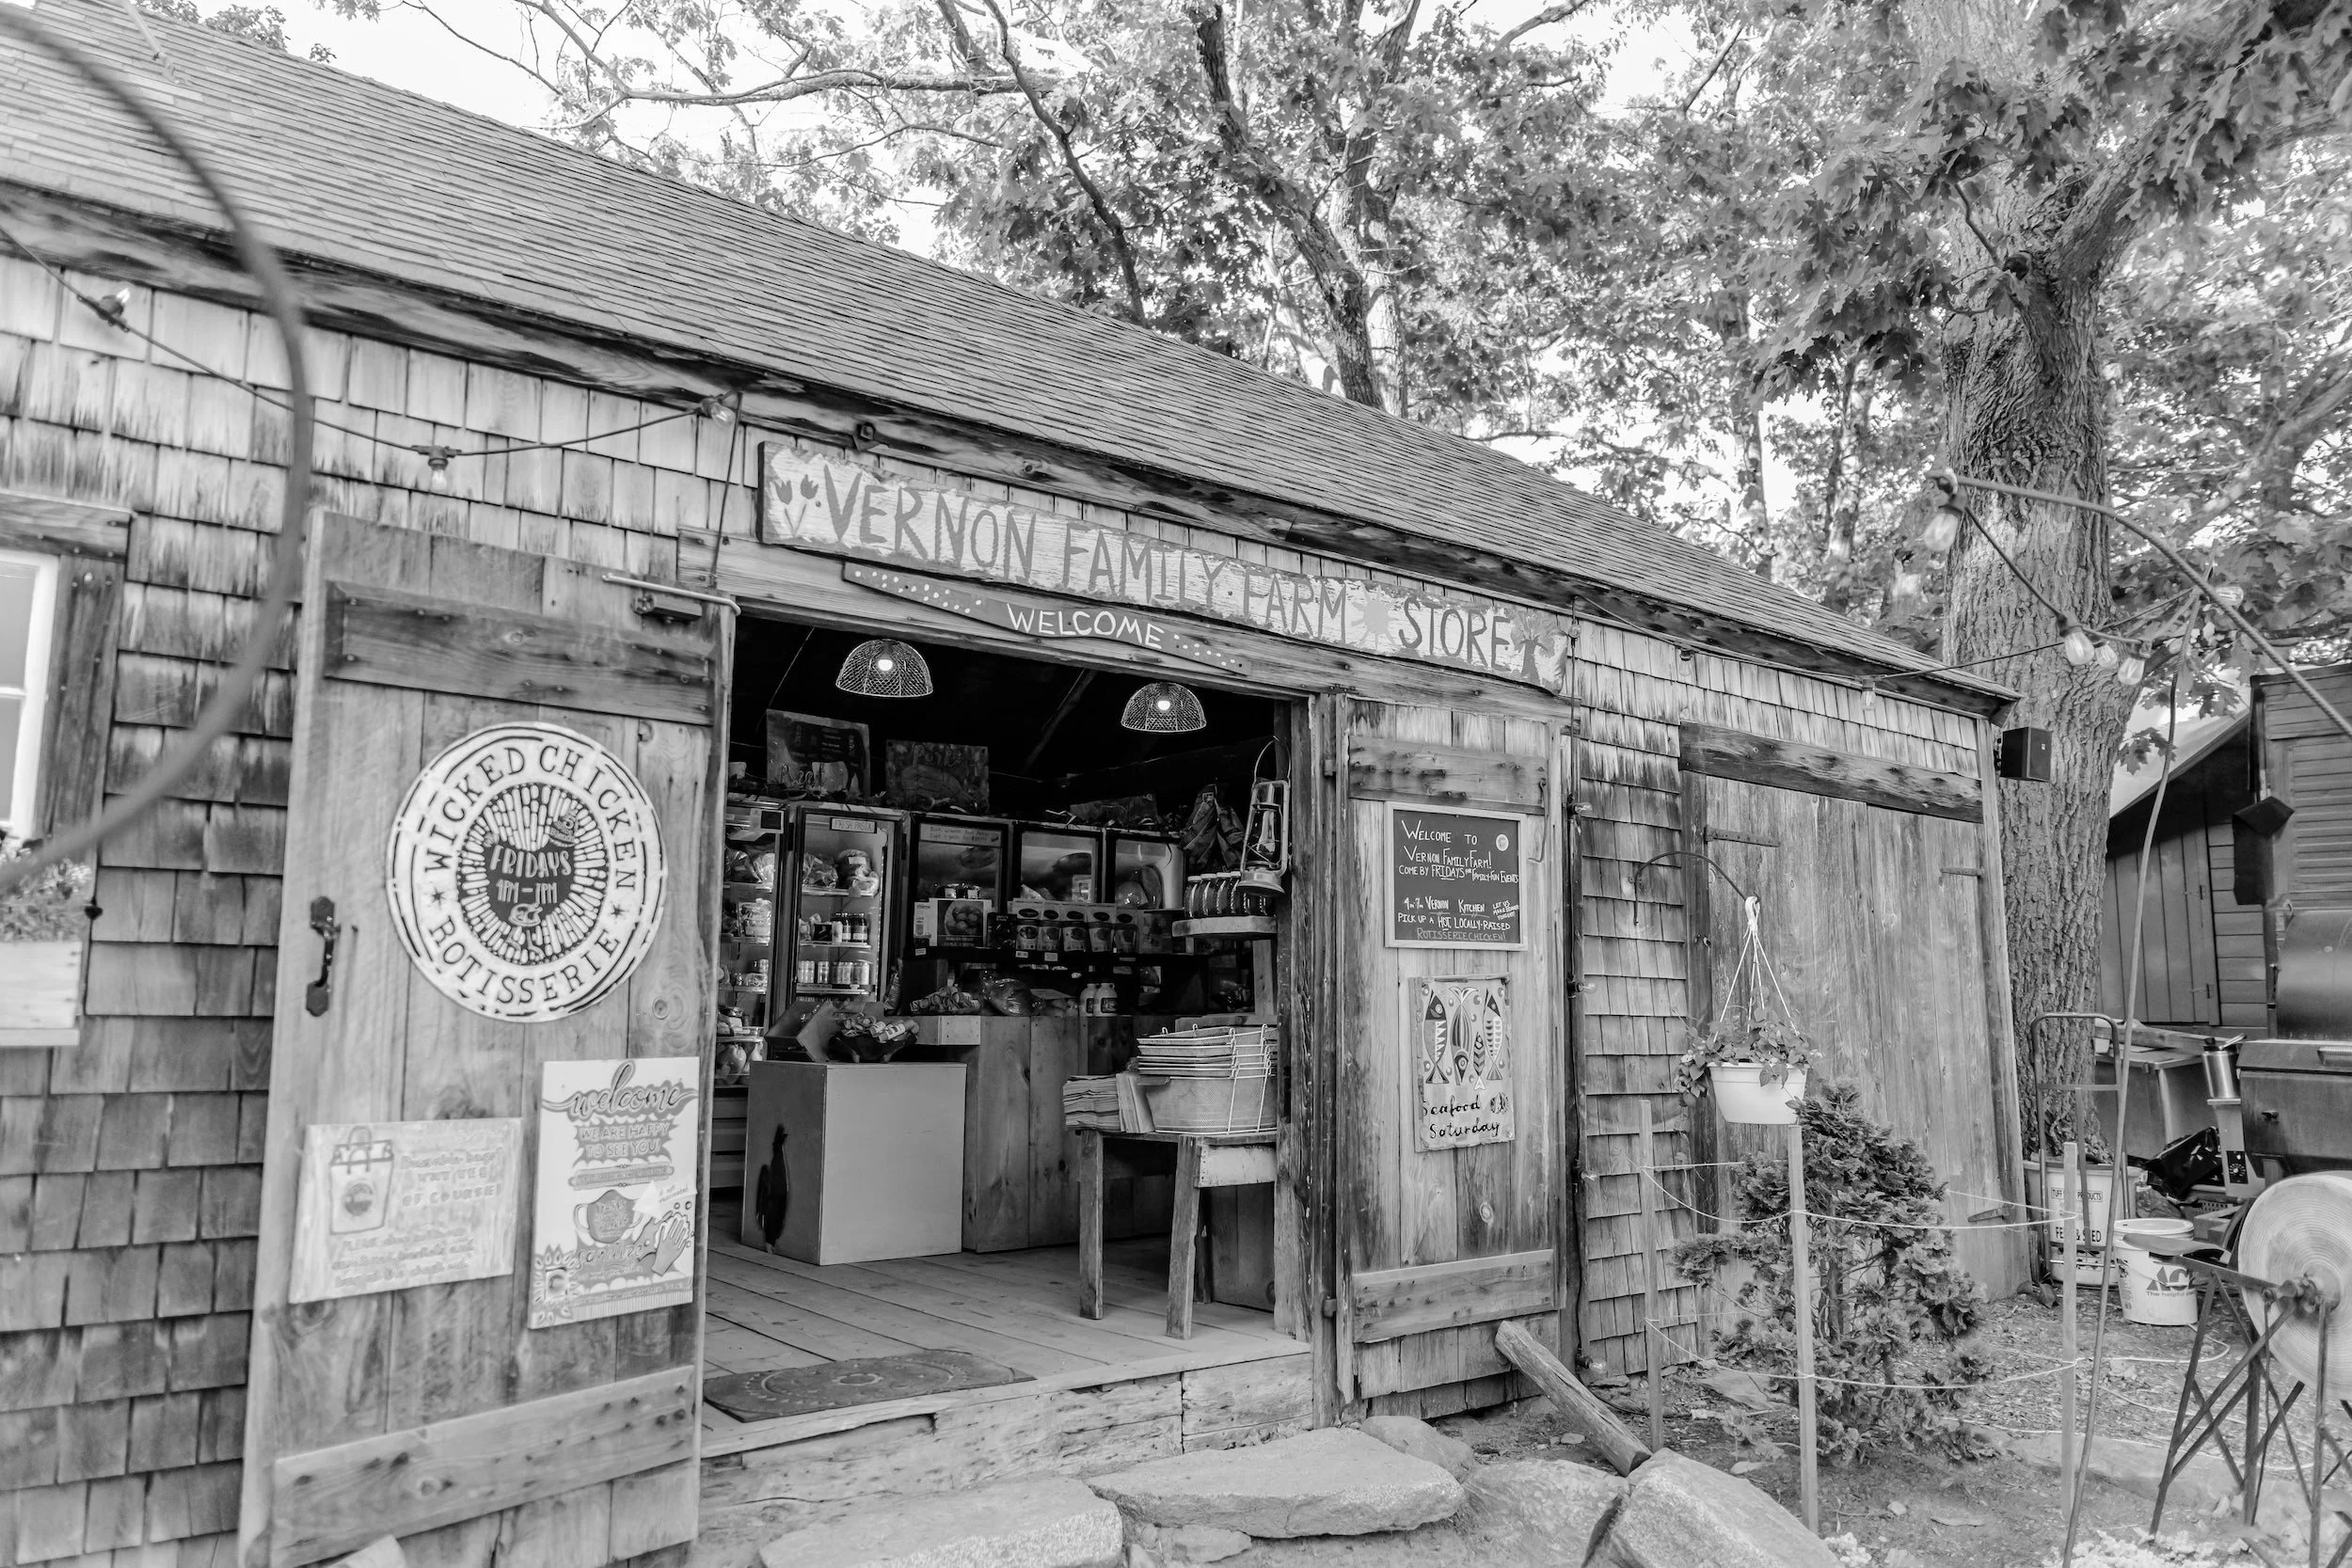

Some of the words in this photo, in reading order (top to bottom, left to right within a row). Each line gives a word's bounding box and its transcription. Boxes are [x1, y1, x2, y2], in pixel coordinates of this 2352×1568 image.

[823, 463, 1037, 583] VERNON
[1061, 521, 1227, 610] FAMILY
[1243, 568, 1347, 645] FARM
[1398, 596, 1511, 672] STORE
[1007, 602, 1166, 650] WELCOME
[424, 747, 526, 872] WICKED
[539, 744, 638, 892] CHICKEN
[1464, 833, 1478, 845] TO
[489, 844, 572, 879] FRIDAYS
[1398, 864, 1419, 876] COME
[1420, 865, 1429, 877] BY
[1431, 863, 1466, 879] FRIDAYS
[1397, 911, 1417, 924] PICK
[1418, 915, 1427, 924] UP
[1429, 916, 1435, 925] A
[429, 914, 621, 1006] ROTISSERIE
[551, 1060, 692, 1117] welcome
[580, 1128, 600, 1142] WE
[602, 1126, 628, 1140] ARE
[629, 1122, 671, 1138] HAPPY
[586, 1143, 604, 1158] TO
[607, 1142, 628, 1157] SEE
[2146, 1265, 2190, 1291] AC
